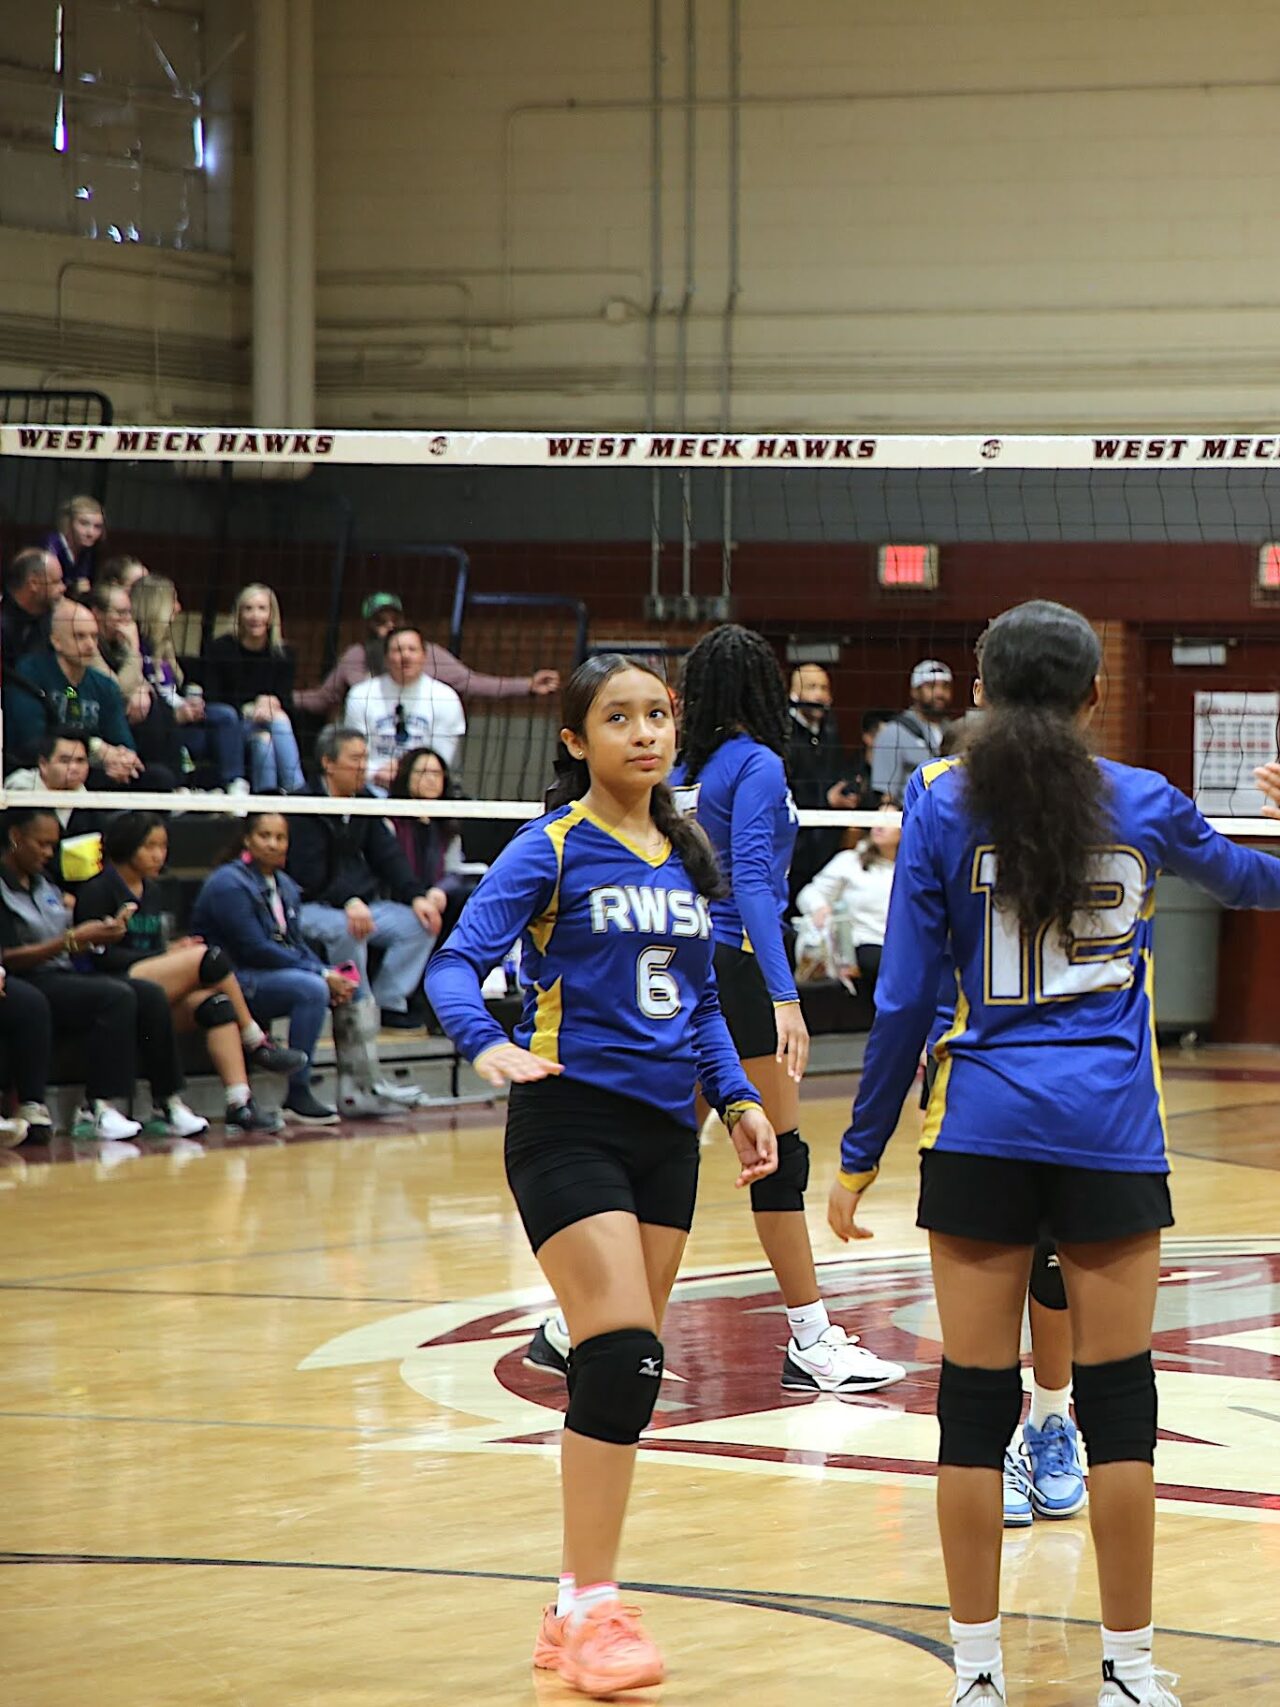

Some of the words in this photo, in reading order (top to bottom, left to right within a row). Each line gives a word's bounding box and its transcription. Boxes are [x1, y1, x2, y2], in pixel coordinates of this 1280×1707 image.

[18, 428, 103, 451] WEST
[115, 430, 204, 453] MECK
[216, 433, 335, 455] HAWKS
[548, 437, 637, 458] WEST
[648, 437, 744, 458] MECK
[754, 438, 877, 459] HAWKS
[1093, 439, 1188, 460] WEST
[969, 843, 1147, 1006] 12
[636, 945, 682, 1020] 6
